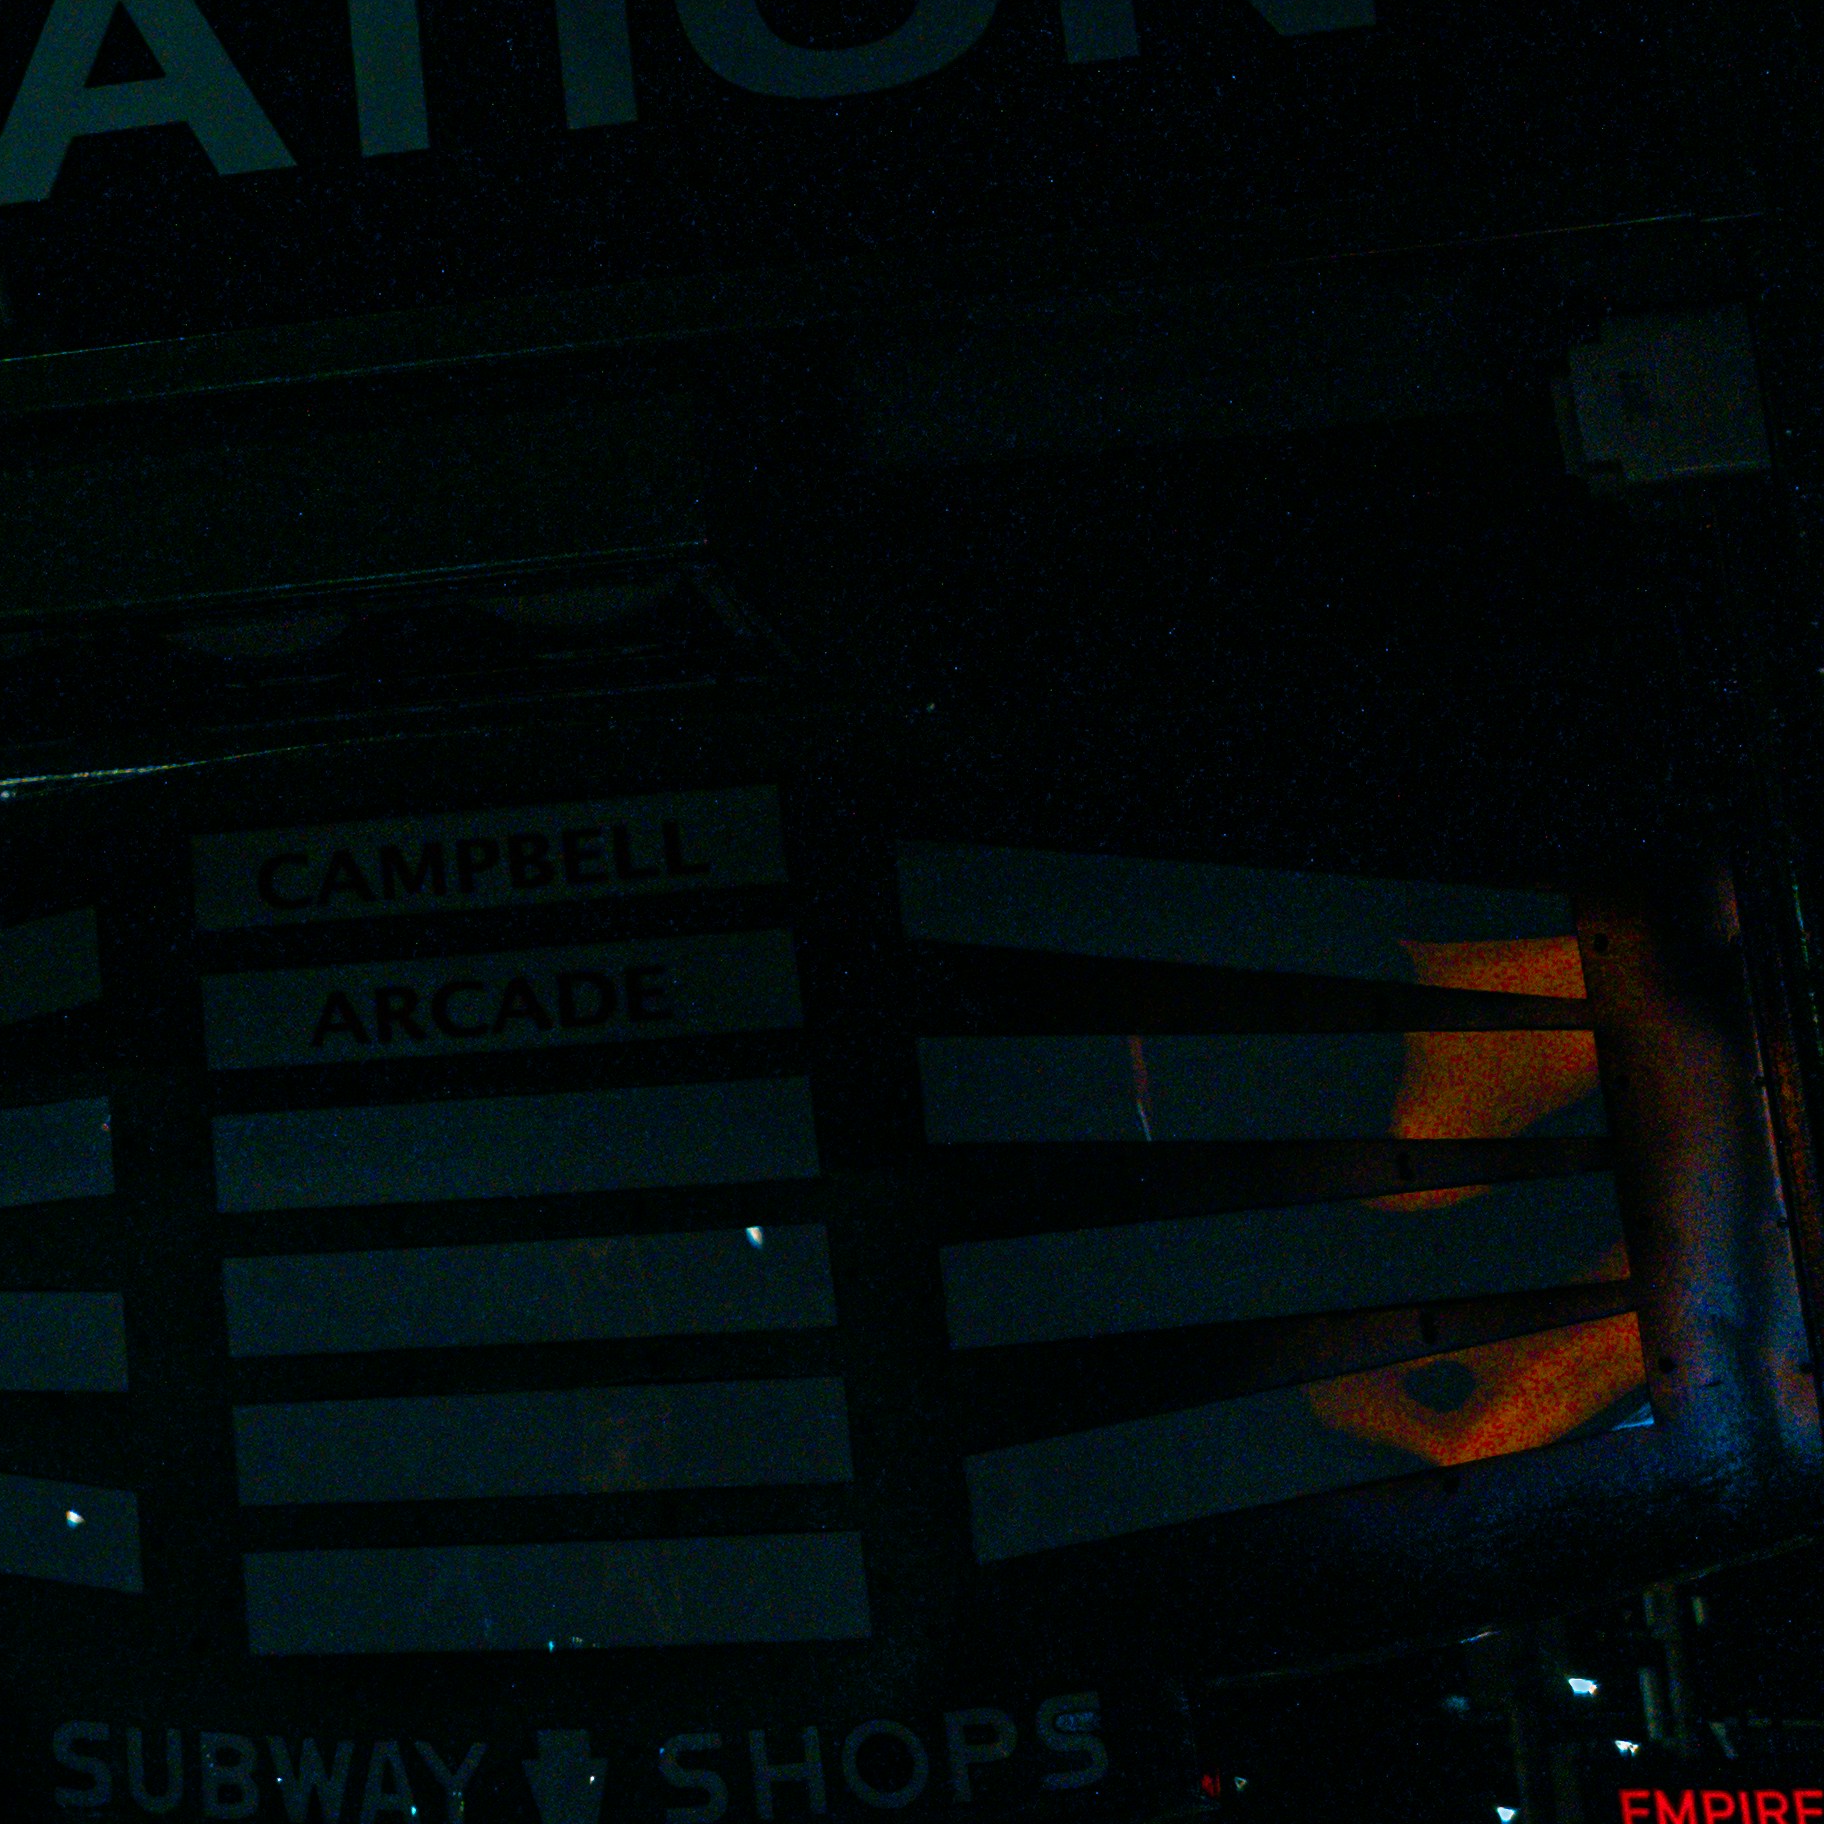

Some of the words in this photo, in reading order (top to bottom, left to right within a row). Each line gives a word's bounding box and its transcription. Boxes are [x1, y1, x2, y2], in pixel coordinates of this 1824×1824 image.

[256, 820, 712, 910] CAMPBELL
[309, 964, 674, 1048] ARCADE
[51, 1719, 488, 1824] SUBWAY
[657, 1690, 1110, 1824] SHOPS
